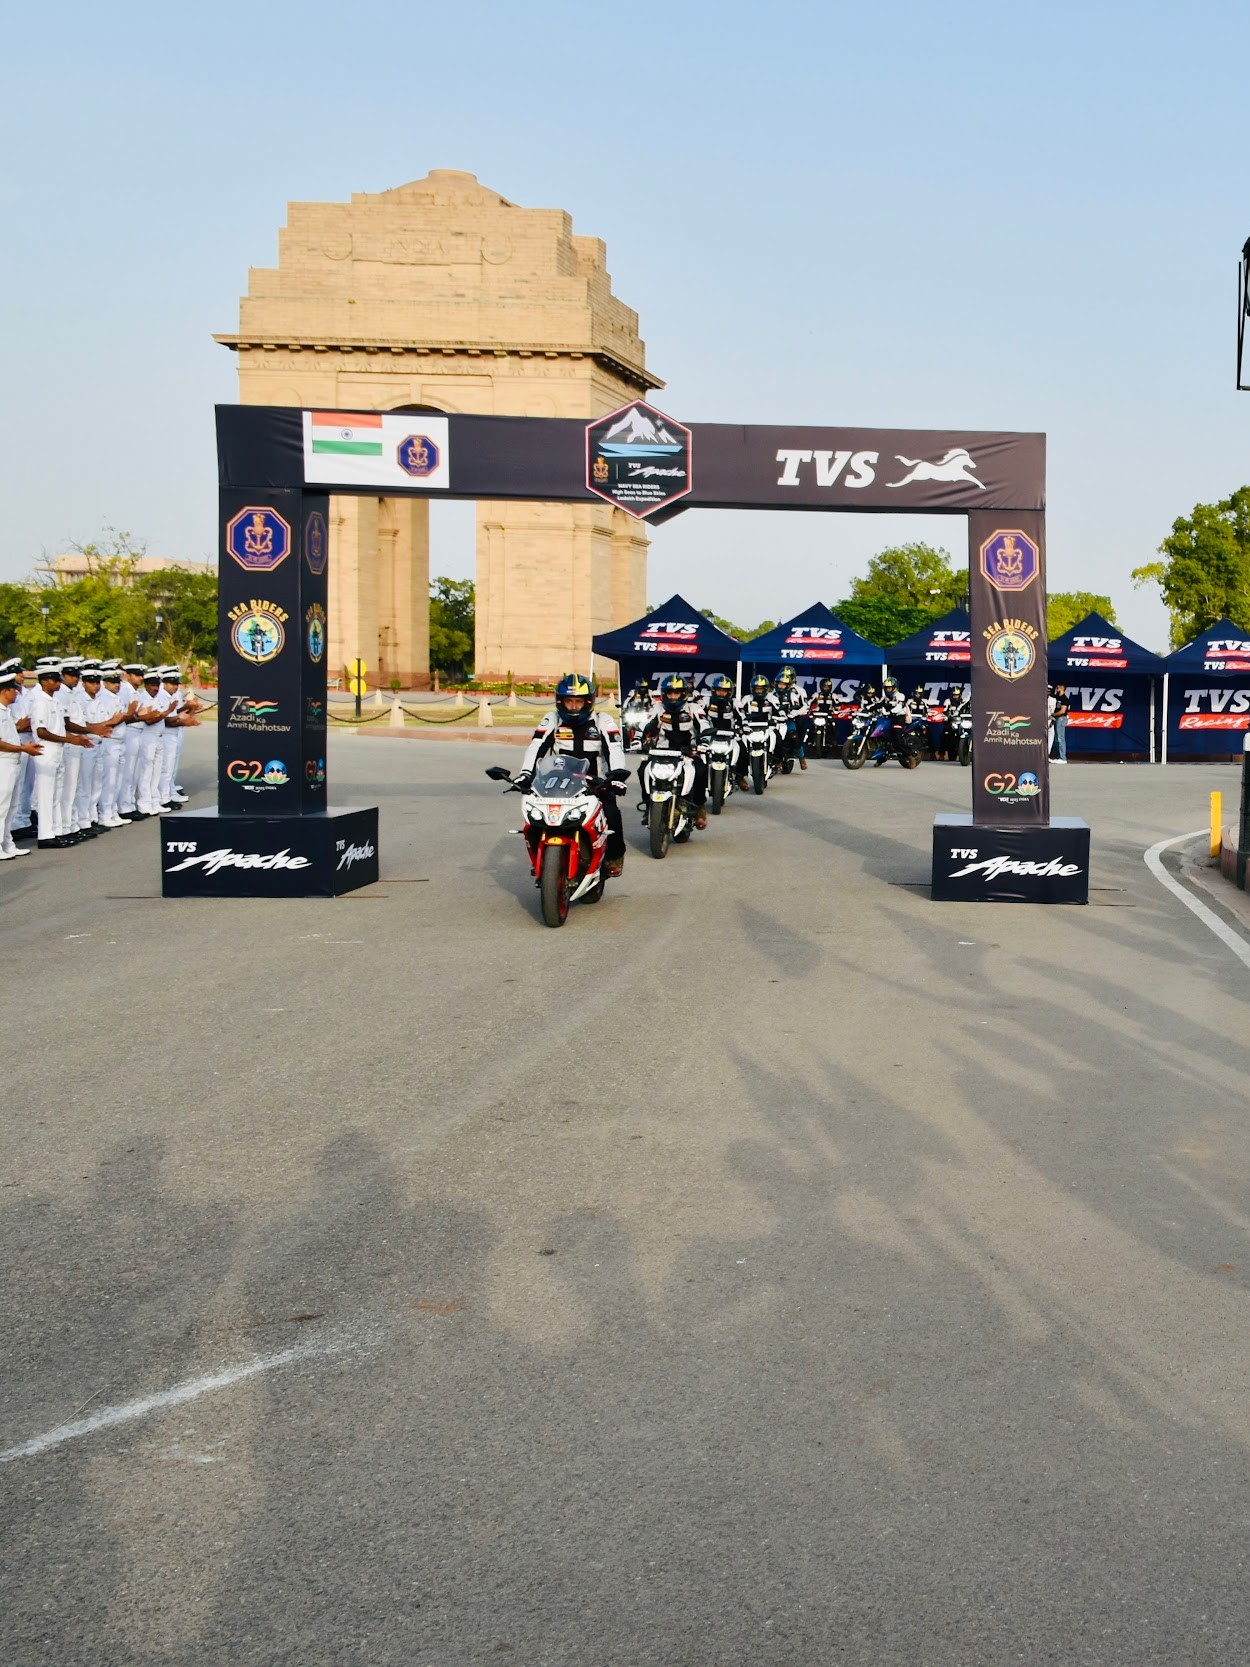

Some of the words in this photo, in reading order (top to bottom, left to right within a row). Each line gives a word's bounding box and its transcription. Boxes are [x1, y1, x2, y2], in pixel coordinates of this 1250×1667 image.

[628, 466, 687, 478] Apache
[776, 449, 879, 488] TVS
[227, 602, 249, 622] SEA
[250, 599, 289, 623] RIDERS
[646, 622, 699, 634] TVS
[791, 627, 842, 639] TVS
[983, 621, 1001, 640] SEA
[1003, 618, 1039, 640] RIDERS
[934, 631, 970, 641] TV
[1073, 636, 1121, 648] TVS
[634, 642, 657, 651] TVS
[657, 644, 694, 653] Racing
[781, 649, 804, 659] TVS
[925, 652, 948, 661] TVS
[1067, 658, 1089, 667] TVS
[1204, 661, 1225, 670] TVS
[1184, 689, 1250, 713] TVS
[229, 713, 255, 722] Azadi
[1181, 716, 1250, 729] Racing
[227, 721, 248, 729] Amrit
[248, 723, 291, 732] Mahotsav
[986, 728, 1010, 736] Azadi
[1003, 737, 1043, 745] Mahotsav
[544, 776, 570, 789] 01
[167, 841, 197, 852] TVS
[335, 839, 345, 851] TVS
[336, 839, 375, 871] Apache
[950, 848, 978, 859] TVS
[165, 848, 312, 876] Apache
[948, 856, 1083, 882] Apache
